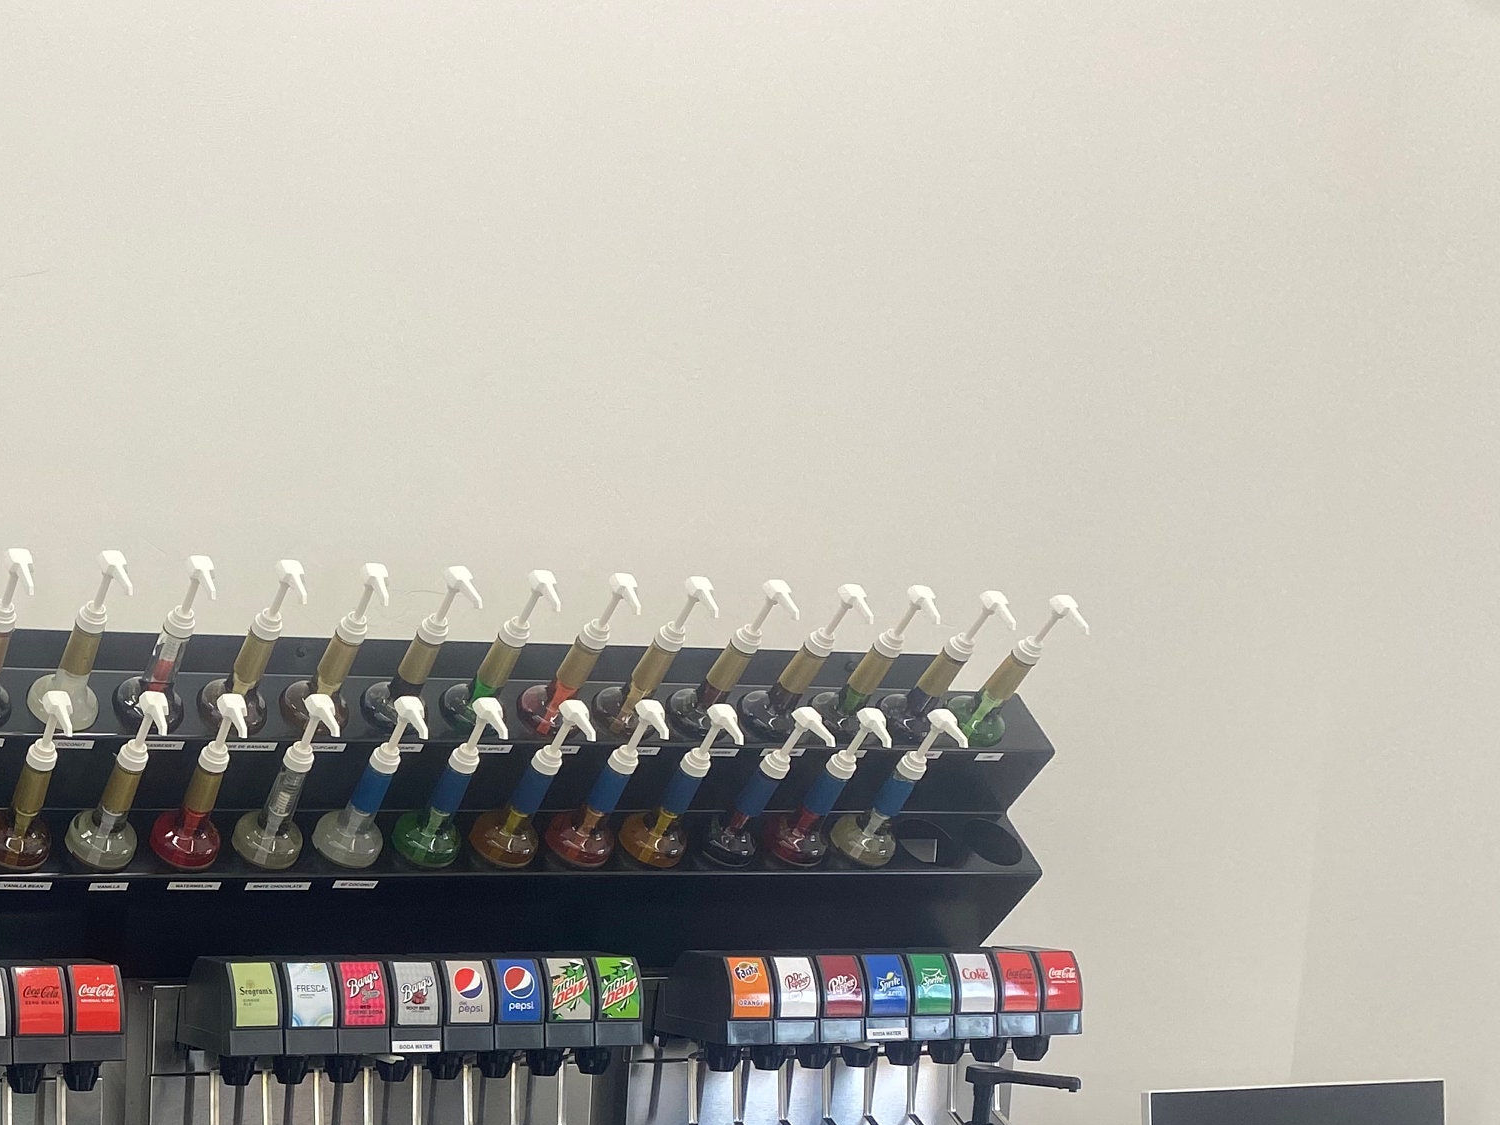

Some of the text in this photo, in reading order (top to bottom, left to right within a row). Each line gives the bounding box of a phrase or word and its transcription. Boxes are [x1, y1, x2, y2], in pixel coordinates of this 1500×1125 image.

[962, 968, 989, 980] Coke
[296, 984, 326, 992] FRESCA
[347, 970, 379, 998] Barq's
[400, 976, 433, 1003] Barq's
[880, 977, 901, 992] Sprite
[240, 986, 273, 996] Seagram's
[458, 1002, 483, 1014] pepsi
[508, 1001, 534, 1012] pepsi
